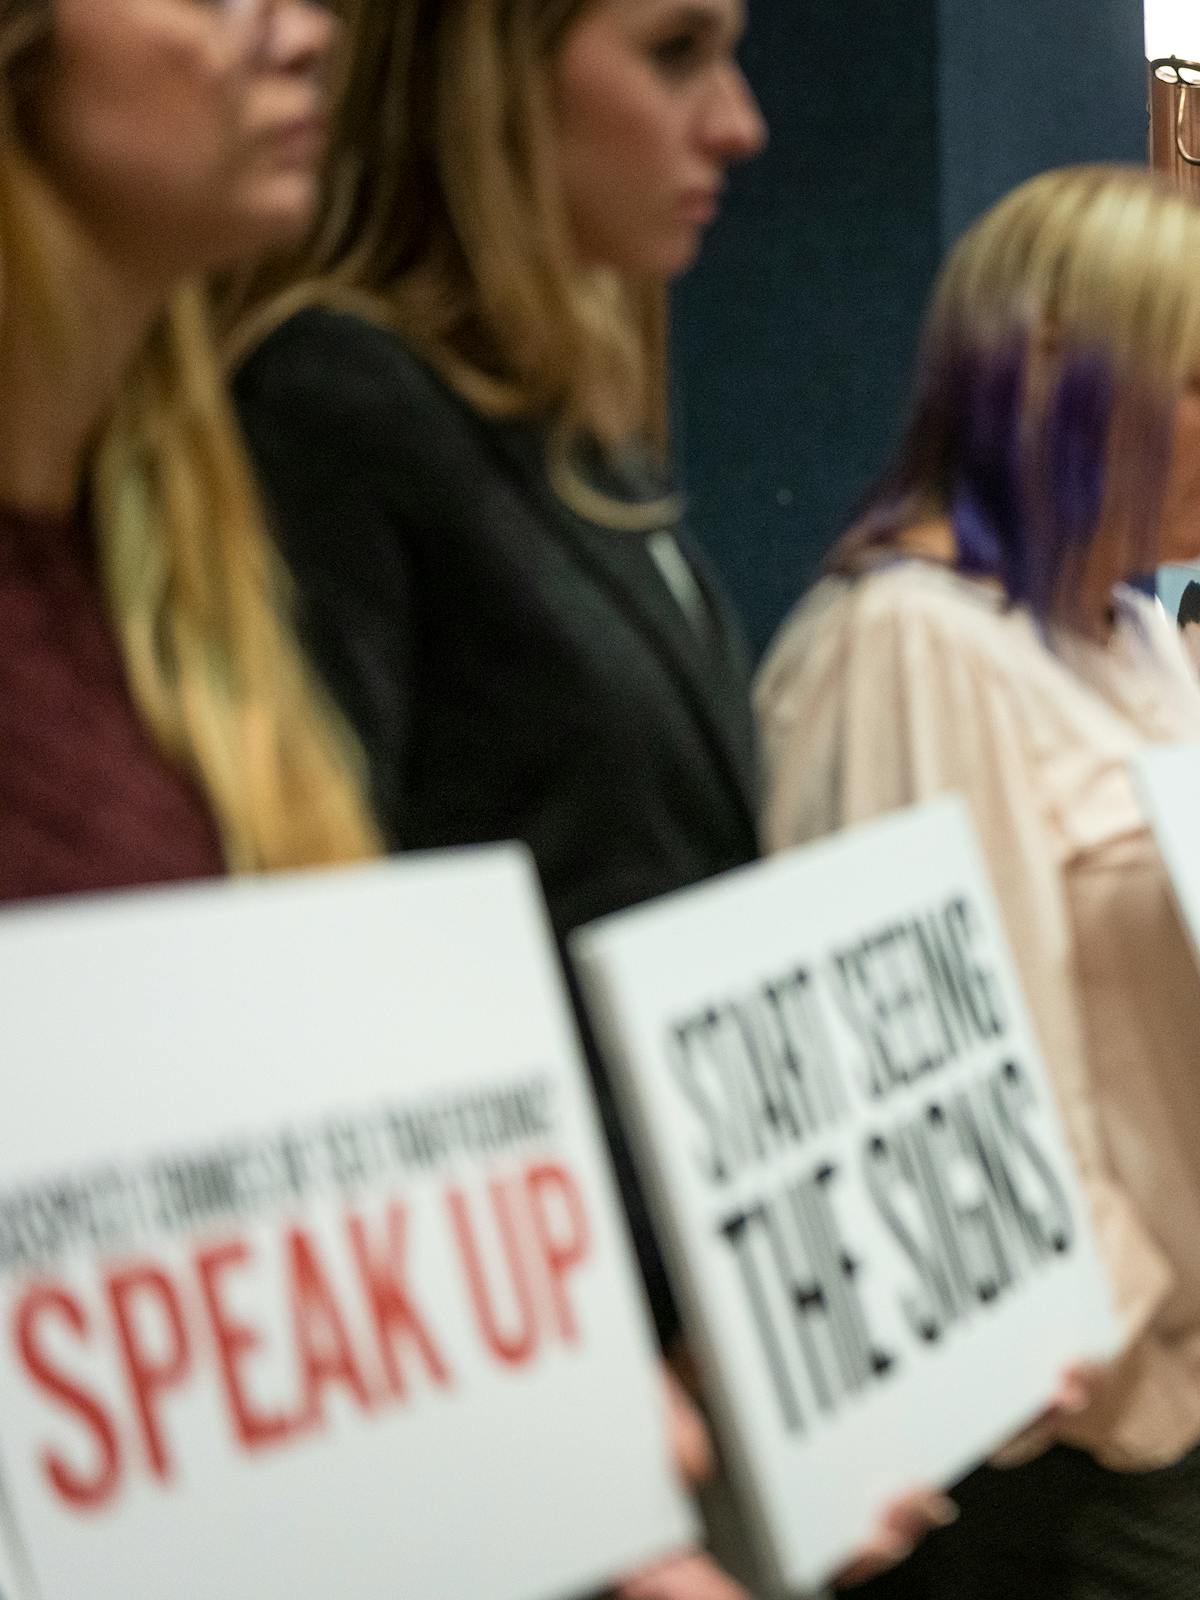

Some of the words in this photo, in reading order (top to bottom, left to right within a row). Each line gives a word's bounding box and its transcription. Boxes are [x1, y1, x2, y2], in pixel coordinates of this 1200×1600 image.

[664, 967, 843, 1183] START
[832, 890, 1006, 1100] SEEING
[11, 1198, 456, 1515] SPEAK
[445, 1158, 593, 1374] UP
[718, 1160, 895, 1437] THE
[860, 1054, 1072, 1347] SIGNS
